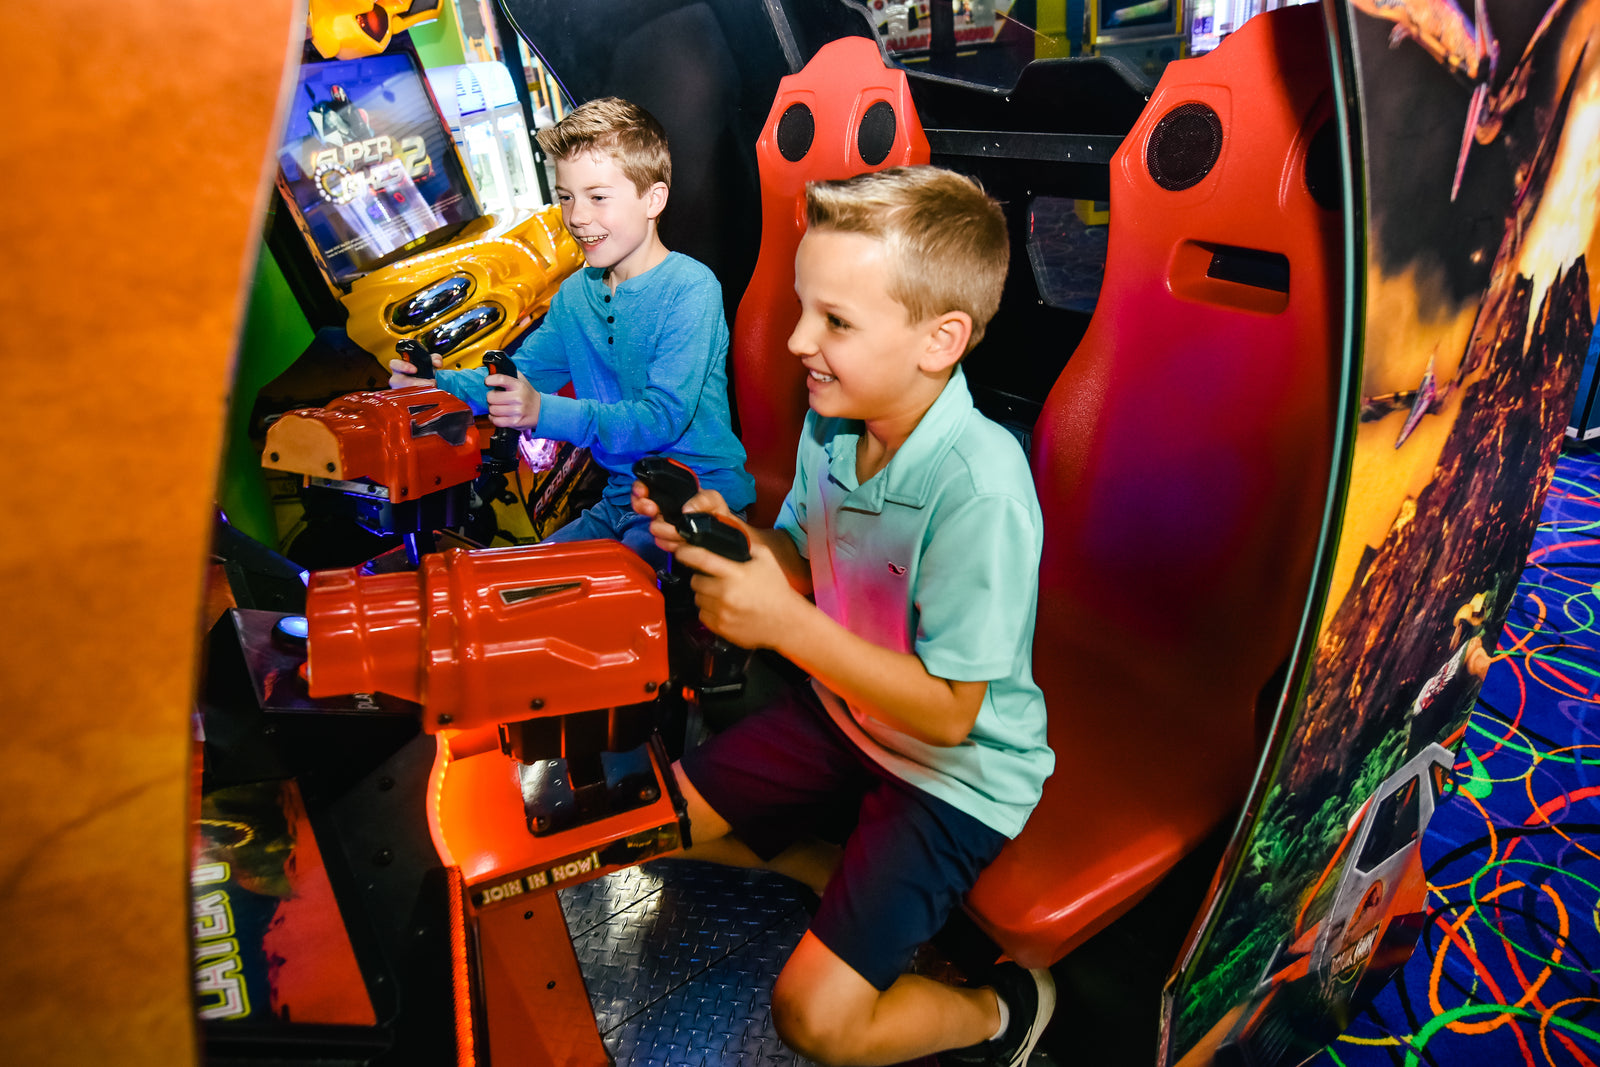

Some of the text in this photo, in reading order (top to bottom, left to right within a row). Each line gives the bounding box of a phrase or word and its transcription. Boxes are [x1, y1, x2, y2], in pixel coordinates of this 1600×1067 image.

[316, 135, 393, 169] SUPER
[401, 135, 428, 179] 2
[482, 851, 600, 905] JOIN IN NOW!
